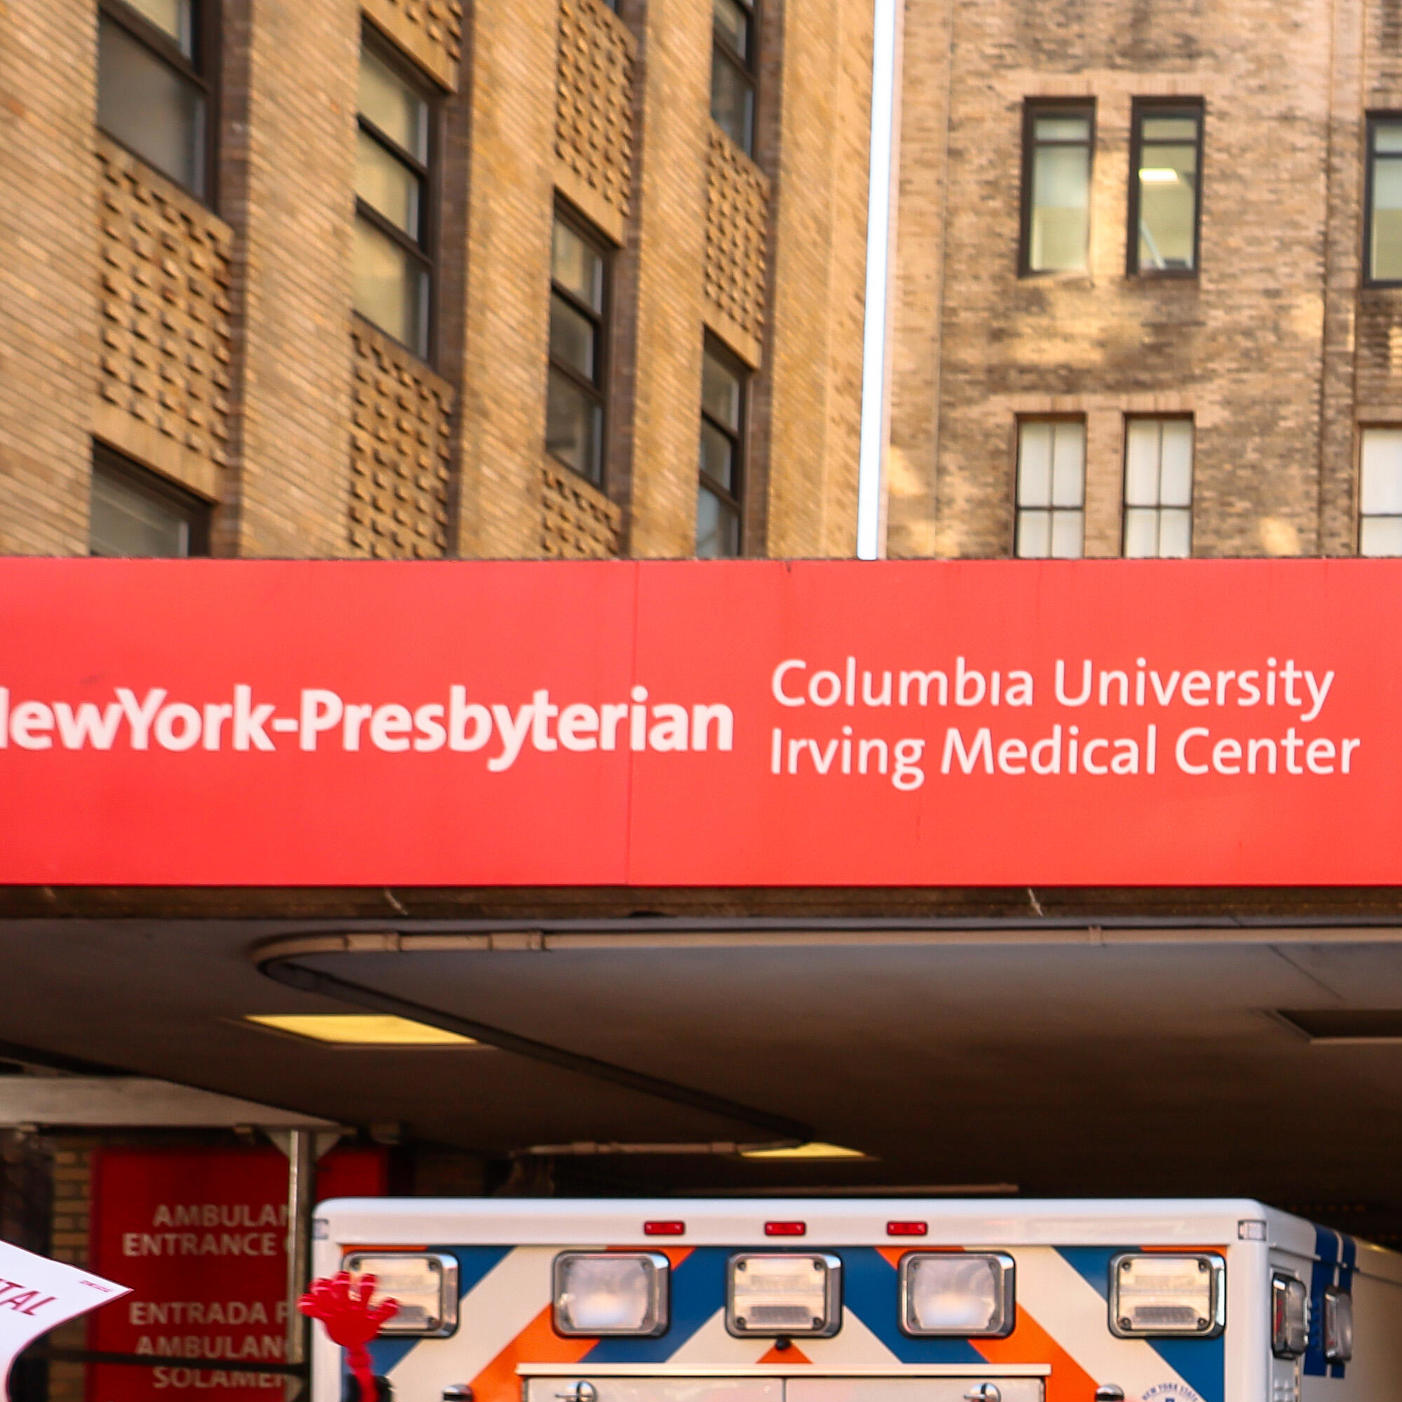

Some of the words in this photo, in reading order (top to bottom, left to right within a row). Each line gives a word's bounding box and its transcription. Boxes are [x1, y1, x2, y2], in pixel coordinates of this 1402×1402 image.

[771, 656, 1034, 706] Columbia
[1054, 656, 1336, 721] University
[0, 684, 734, 772] ewYork-Presbyterian
[770, 725, 925, 790] Irving
[941, 725, 1157, 775] Medical
[1174, 725, 1361, 776] Center
[122, 1232, 277, 1256] ENTRANCE
[129, 1301, 268, 1325] ENTRADA
